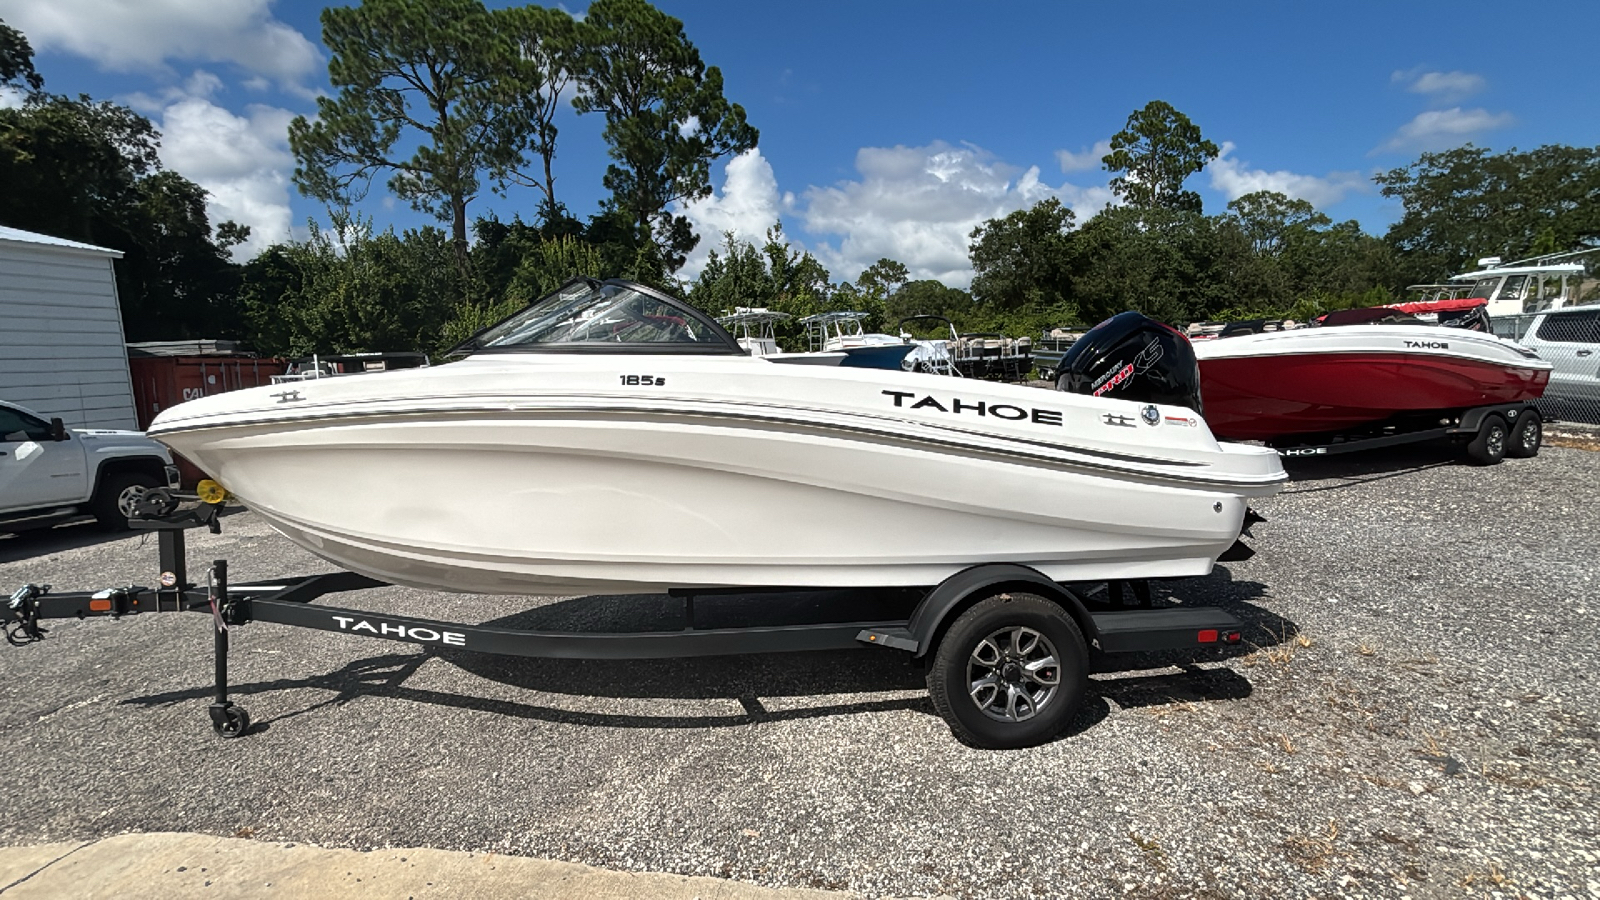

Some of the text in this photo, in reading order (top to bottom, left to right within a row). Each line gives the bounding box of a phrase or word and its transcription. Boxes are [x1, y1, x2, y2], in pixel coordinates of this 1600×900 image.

[1403, 341, 1449, 349] TAHOE
[881, 389, 1063, 427] TAHOE
[1277, 447, 1327, 456] HOE
[332, 616, 466, 646] TAHOE
